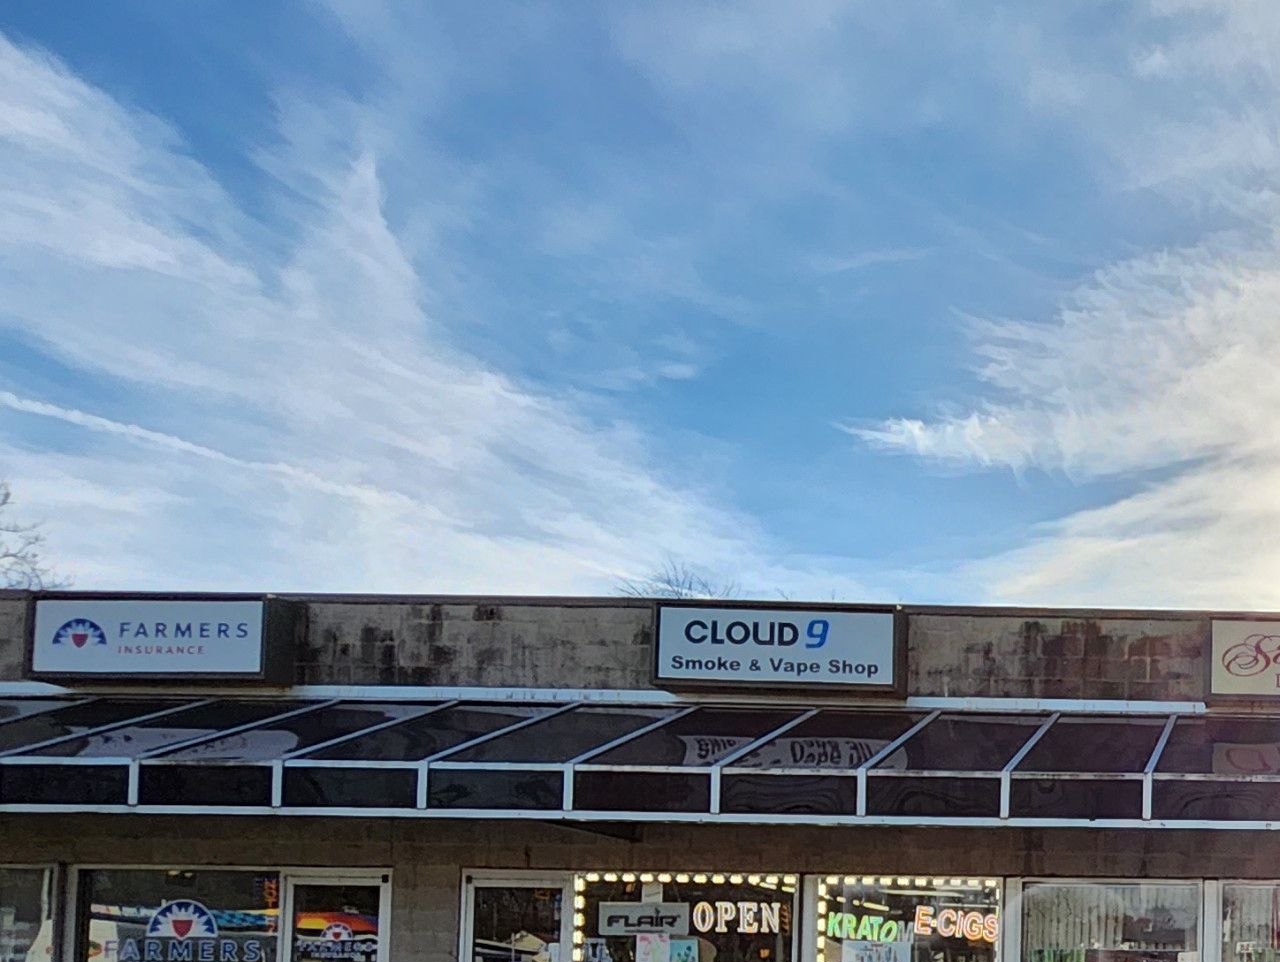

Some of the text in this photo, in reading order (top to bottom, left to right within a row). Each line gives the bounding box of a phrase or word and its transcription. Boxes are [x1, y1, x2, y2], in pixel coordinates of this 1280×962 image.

[118, 622, 249, 638] FARMERS
[685, 619, 830, 649] CLOUD 9
[118, 645, 205, 655] INSURANCE
[671, 656, 879, 678] Smoke & Vape Shop
[607, 908, 679, 927] FLAIR
[693, 901, 781, 934] OPEN
[827, 911, 914, 943] KRATOM
[103, 939, 261, 962] FARMERS
